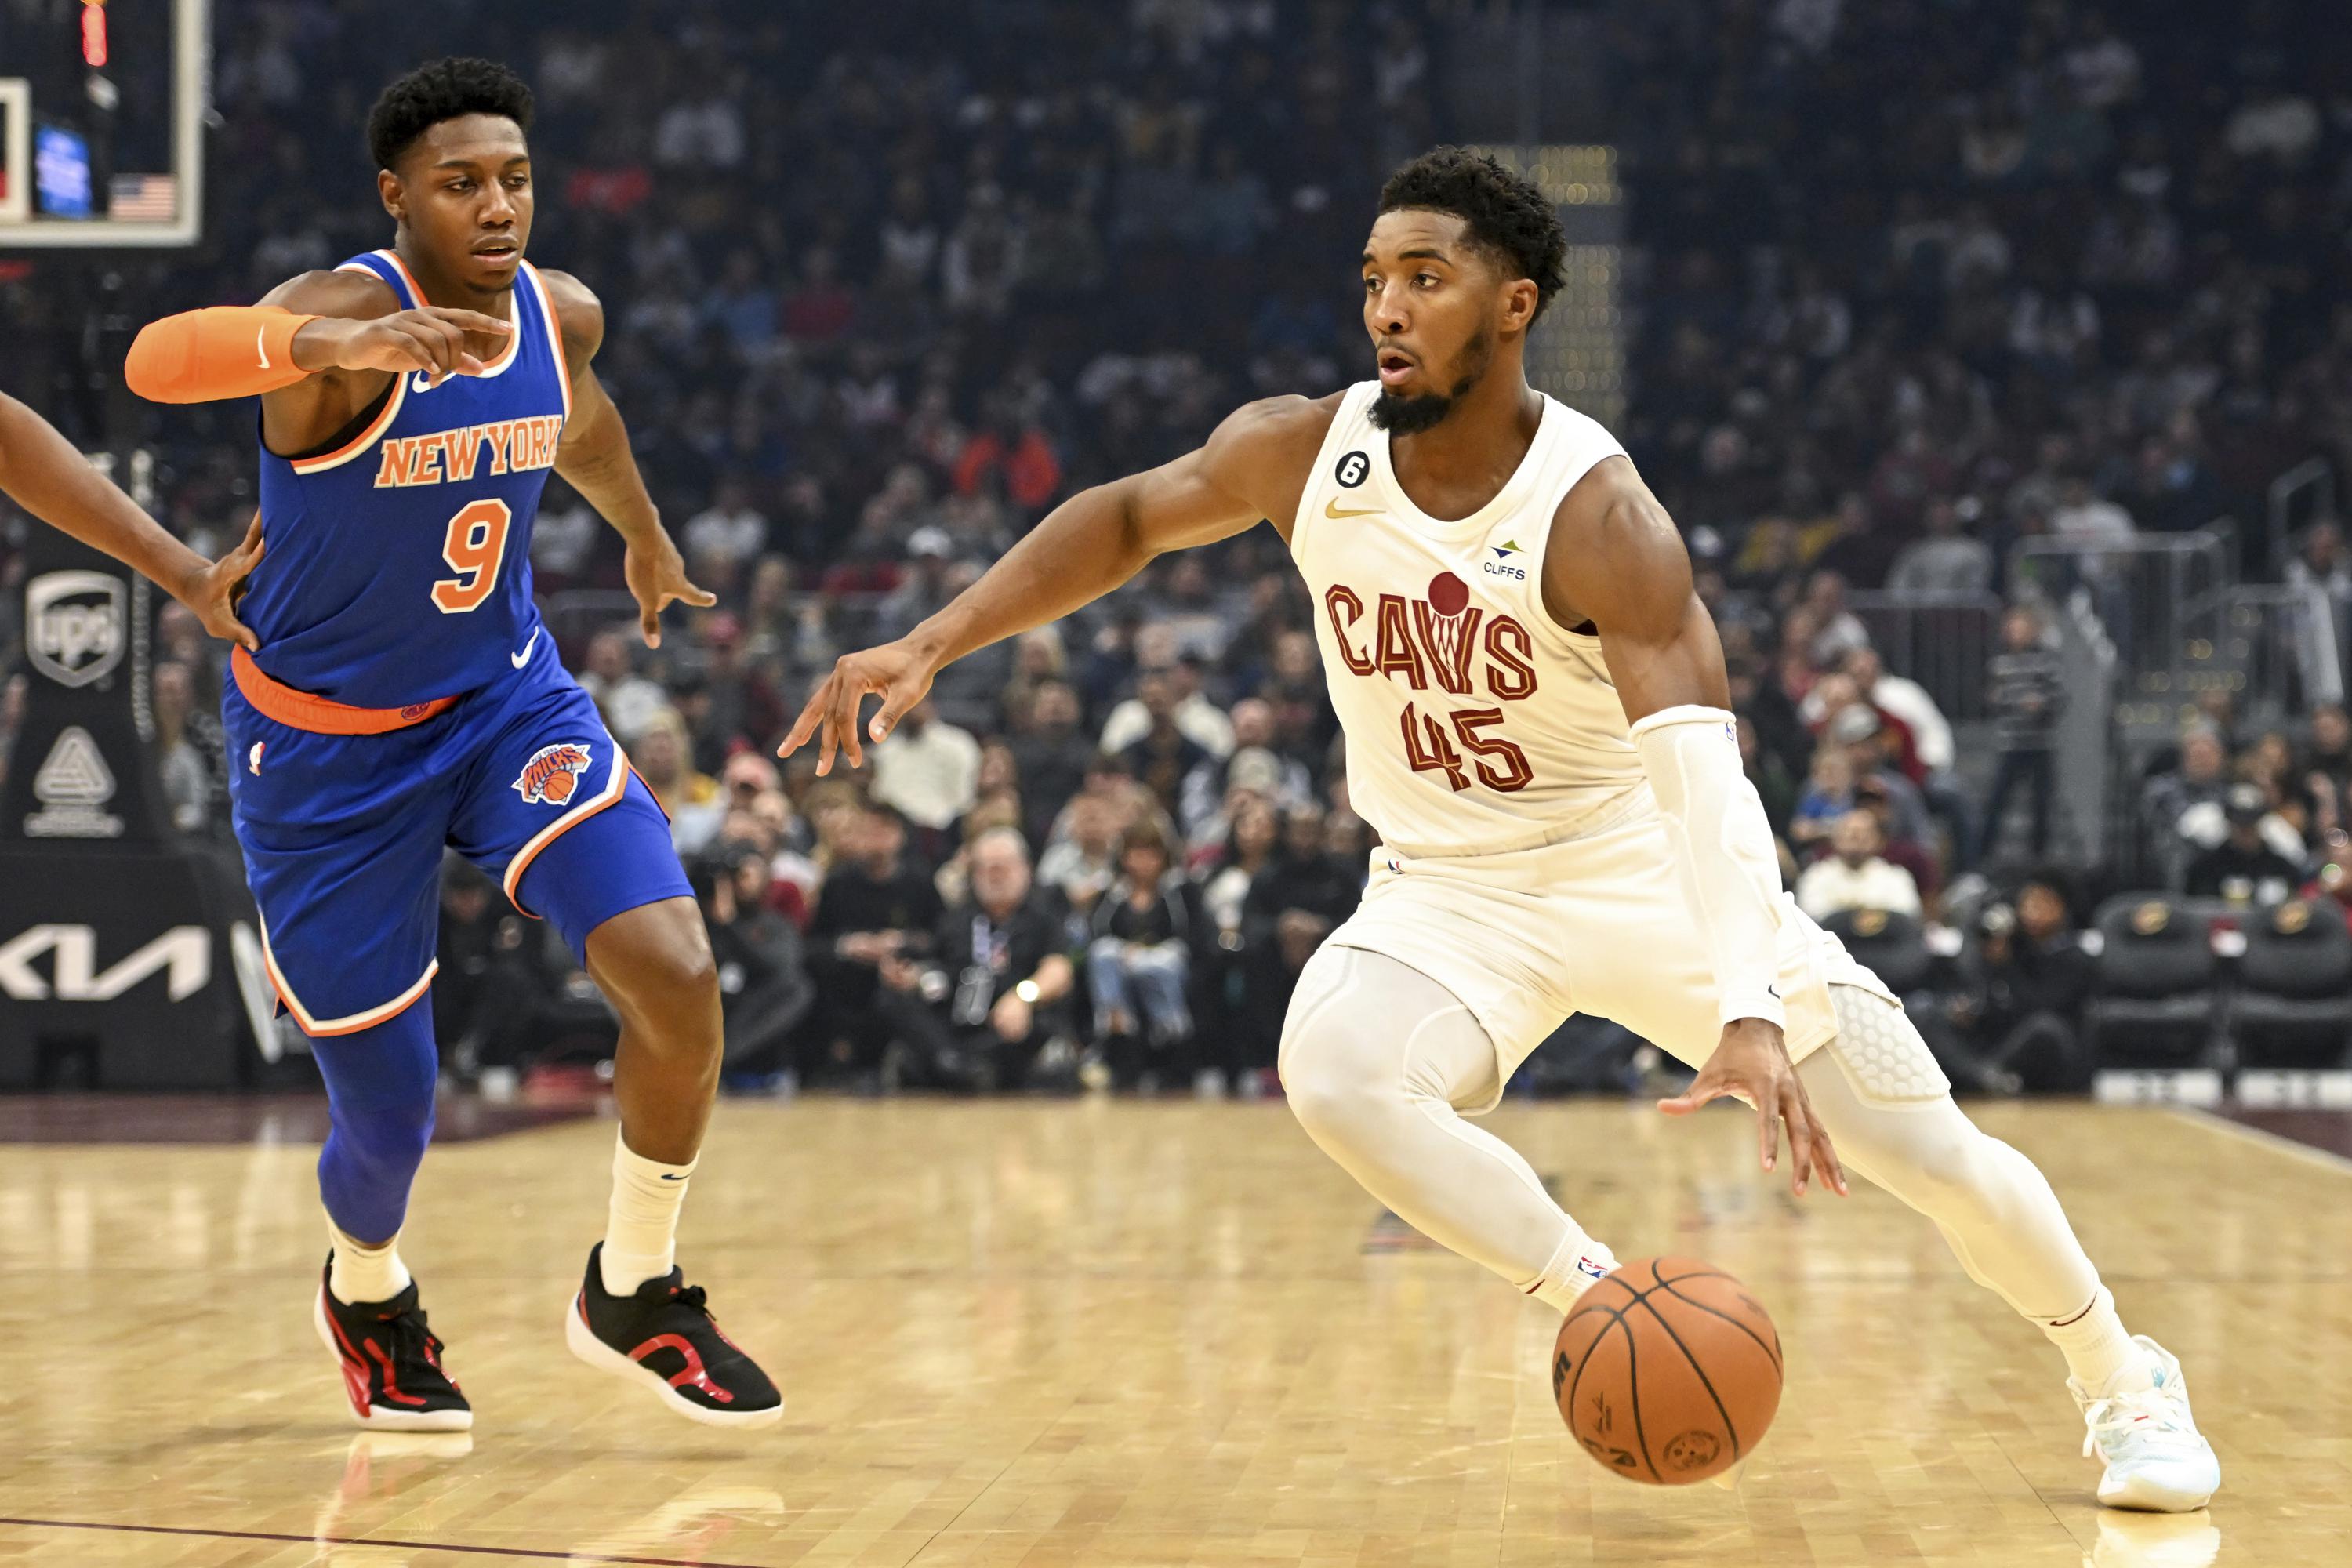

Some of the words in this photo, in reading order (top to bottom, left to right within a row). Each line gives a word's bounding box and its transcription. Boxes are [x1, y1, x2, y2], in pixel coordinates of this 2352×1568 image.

[374, 426, 485, 488] NEW
[485, 414, 563, 476] YORK
[1340, 456, 1365, 485] 6
[430, 498, 512, 614] 9
[1483, 561, 1526, 581] CLIFFS
[1325, 583, 1538, 701] CAVS
[523, 746, 588, 799] KNICKS
[1400, 700, 1534, 793] 45
